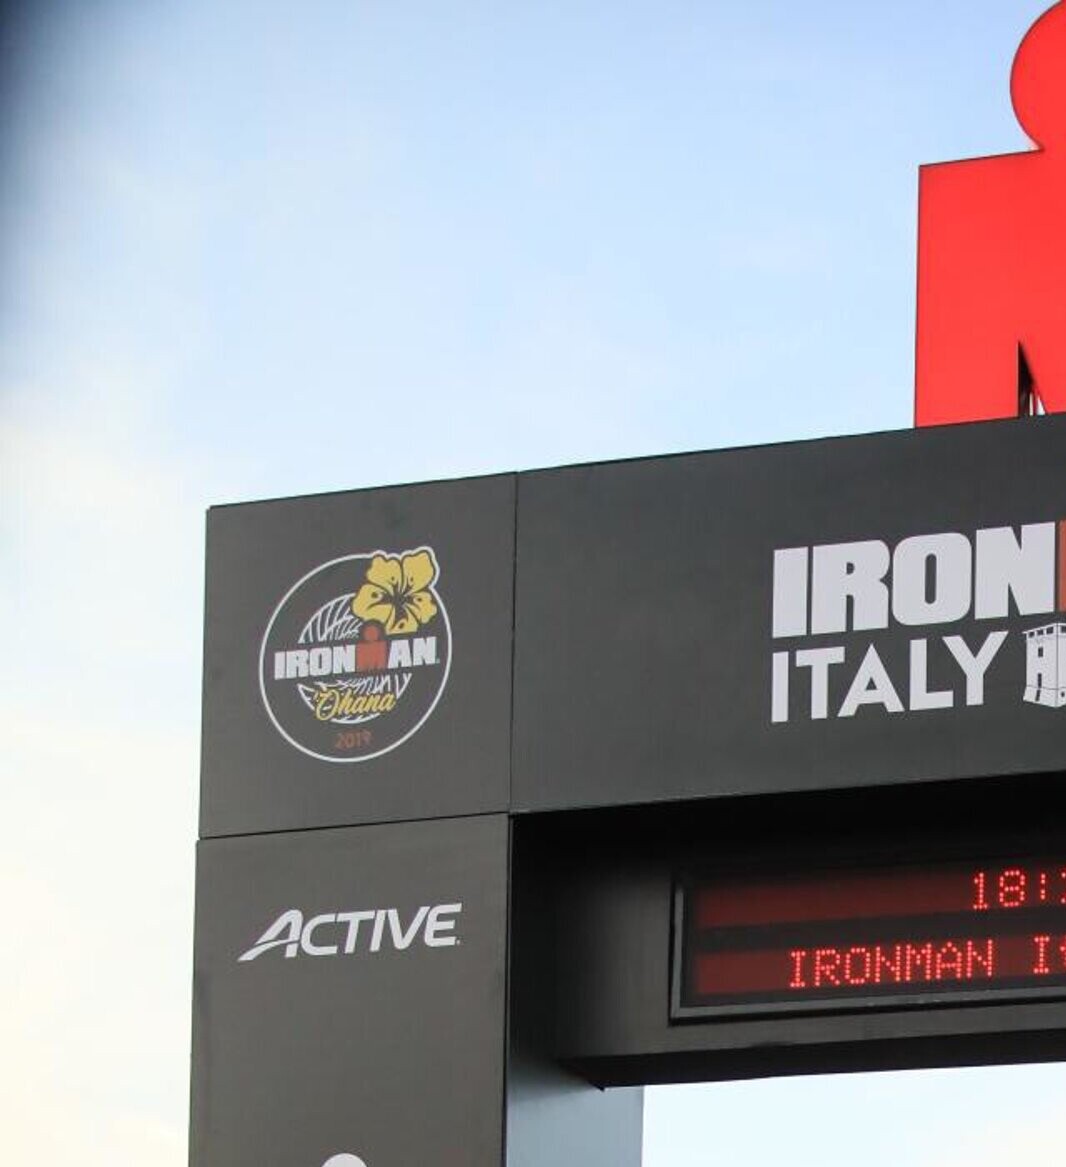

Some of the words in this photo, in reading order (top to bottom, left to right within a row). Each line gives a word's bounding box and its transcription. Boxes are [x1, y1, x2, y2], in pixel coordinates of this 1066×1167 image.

[274, 624, 438, 680] IRONMAN
[772, 631, 1008, 723] ITALY
[334, 729, 373, 749] 2019
[238, 903, 462, 961] ACTIVE
[790, 938, 994, 988] IRONMAN
